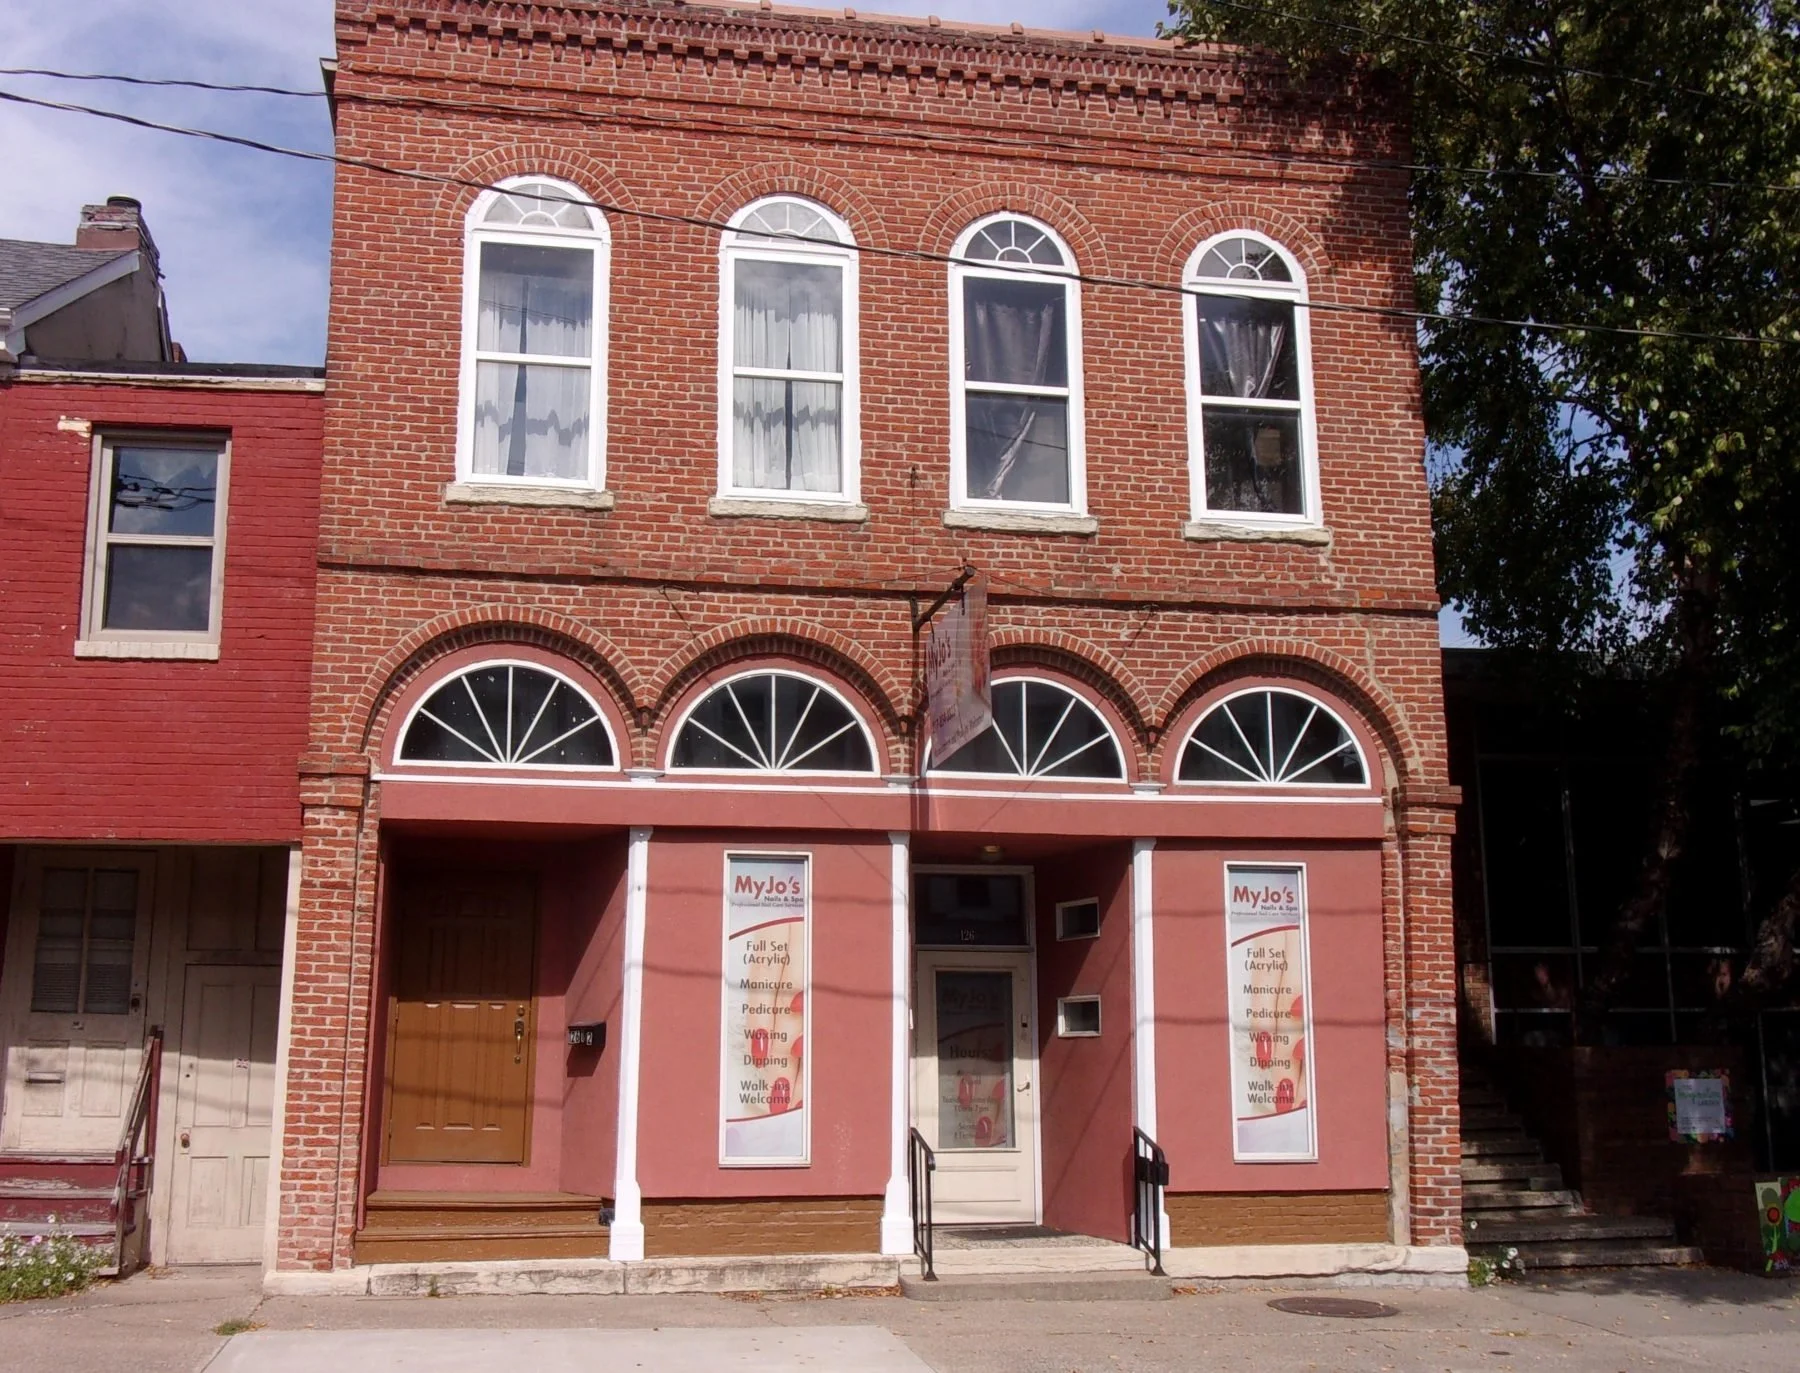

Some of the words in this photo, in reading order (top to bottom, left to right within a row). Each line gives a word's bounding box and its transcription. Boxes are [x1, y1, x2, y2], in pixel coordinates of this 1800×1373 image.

[734, 875, 801, 900] MyJo's
[791, 896, 804, 904] Spa
[1233, 885, 1294, 908] MyJo's
[746, 940, 766, 952] Full
[770, 940, 789, 952] Set
[1247, 948, 1265, 958] Full
[1268, 948, 1286, 958] Set
[743, 953, 791, 966] (Acrylic)
[1244, 959, 1288, 971] (Acrylic)
[740, 978, 793, 989] Manicure
[1243, 984, 1292, 994] Manicure
[742, 1003, 791, 1015] Pedicure
[1246, 1008, 1291, 1019] Pedicure
[744, 1029, 788, 1042] Waxing
[1249, 1032, 1289, 1045] Waxing
[743, 1055, 788, 1068] Dipping
[1249, 1057, 1291, 1069] Dipping
[740, 1080, 790, 1091] Walk-ins
[1248, 1080, 1294, 1091] Walk-ins
[739, 1093, 790, 1104] Welcome
[1247, 1093, 1295, 1104] Welcome
